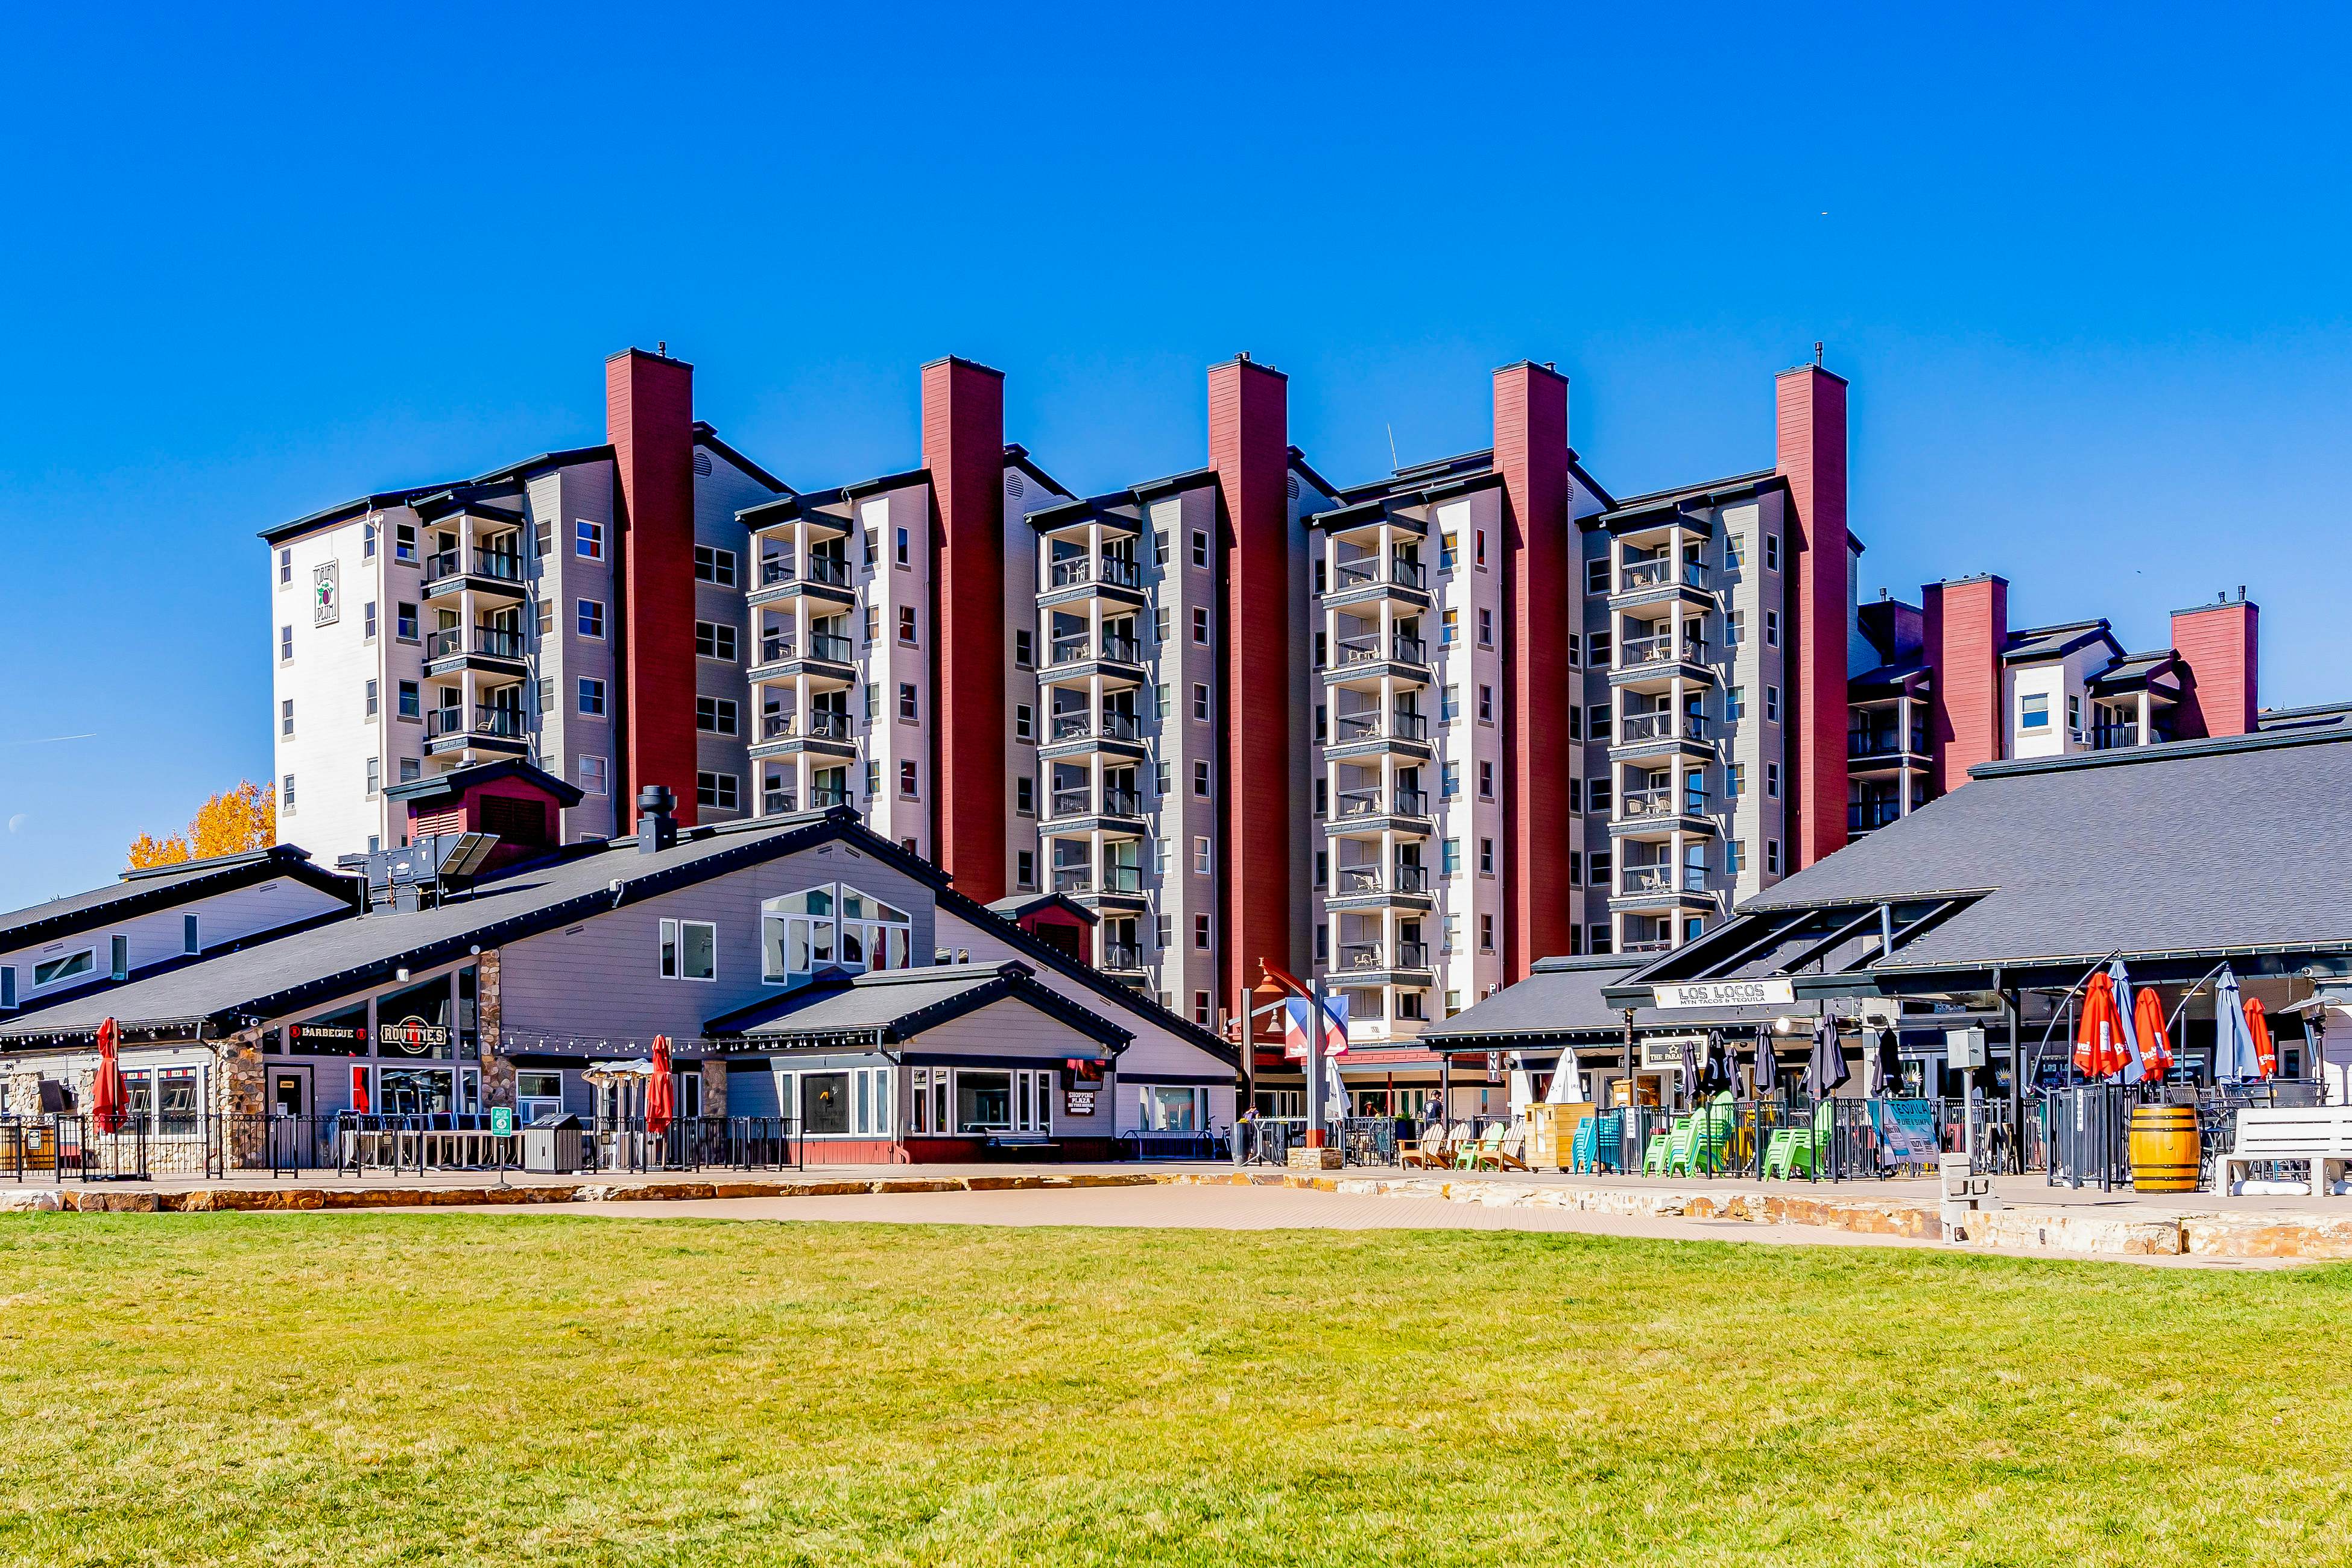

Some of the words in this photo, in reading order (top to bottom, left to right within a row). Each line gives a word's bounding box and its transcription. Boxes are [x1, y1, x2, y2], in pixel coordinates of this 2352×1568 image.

[313, 563, 336, 585] TORIAN
[317, 604, 334, 622] PLUM
[1678, 987, 1708, 1000] LOS
[1713, 984, 1765, 998] LOCOS
[302, 1028, 353, 1038] BARBECUE
[384, 1028, 443, 1042] ROUTTIE'S
[1891, 1103, 1928, 1114] TEQUILA
